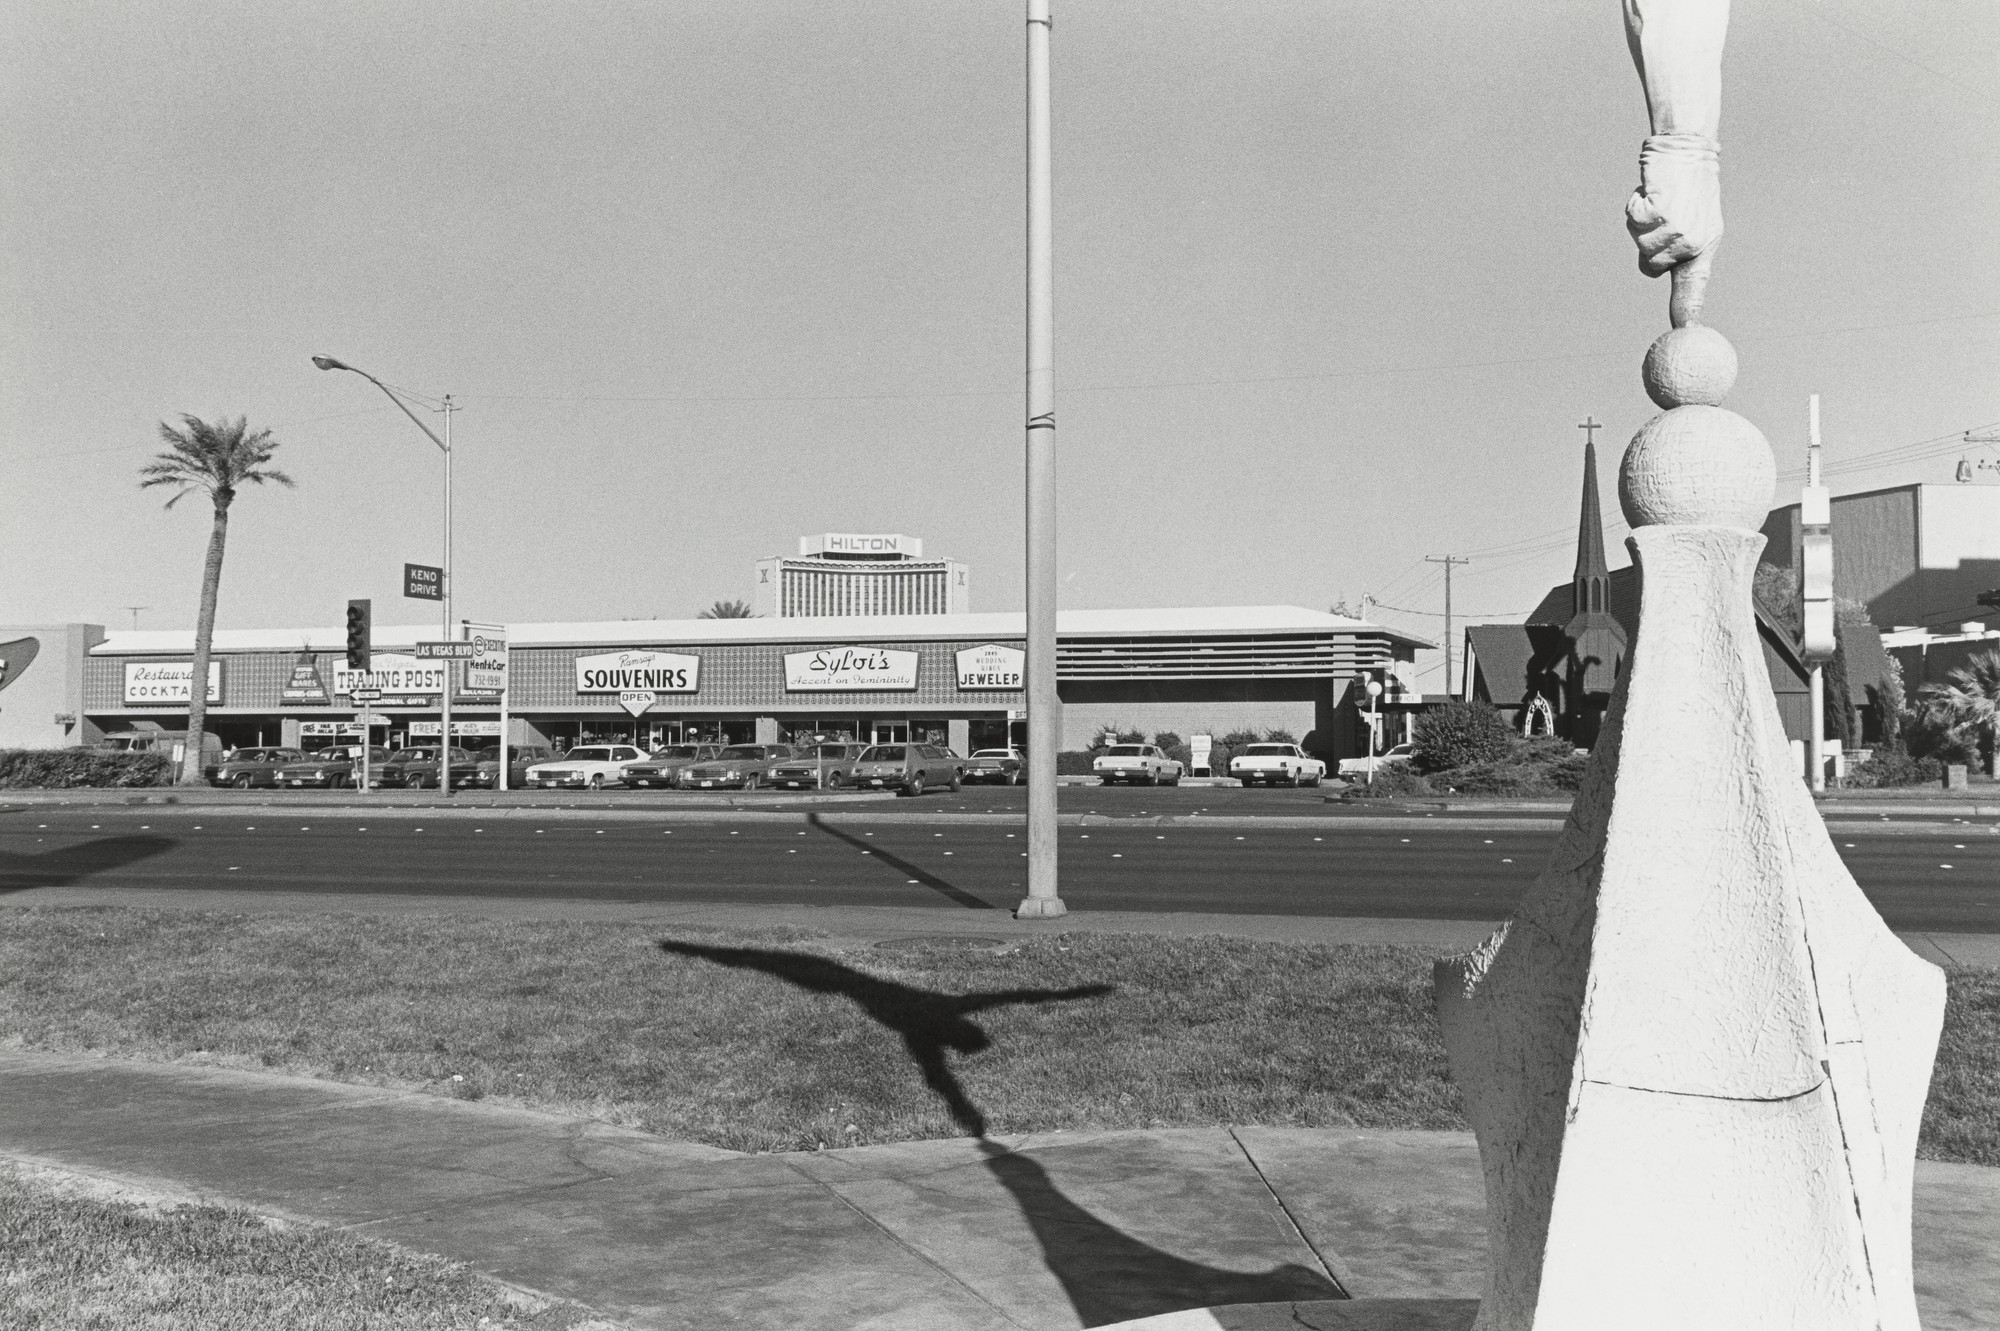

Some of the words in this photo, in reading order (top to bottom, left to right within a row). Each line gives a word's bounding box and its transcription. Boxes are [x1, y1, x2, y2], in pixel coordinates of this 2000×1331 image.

[831, 537, 897, 550] HILTON
[410, 569, 438, 582] KENO
[410, 583, 438, 596] DRIVE
[417, 645, 430, 656] LAS
[432, 645, 453, 656] VEGAS
[455, 645, 472, 657] BLVD
[134, 667, 195, 682] Restaura
[405, 669, 444, 689] POST
[584, 669, 687, 688] SOUVENIRS
[791, 676, 831, 685] Accent
[960, 673, 1020, 686] JEWELER
[129, 684, 215, 696] COCKTAS
[621, 693, 652, 701] OPEN
[413, 723, 436, 734] FREE
